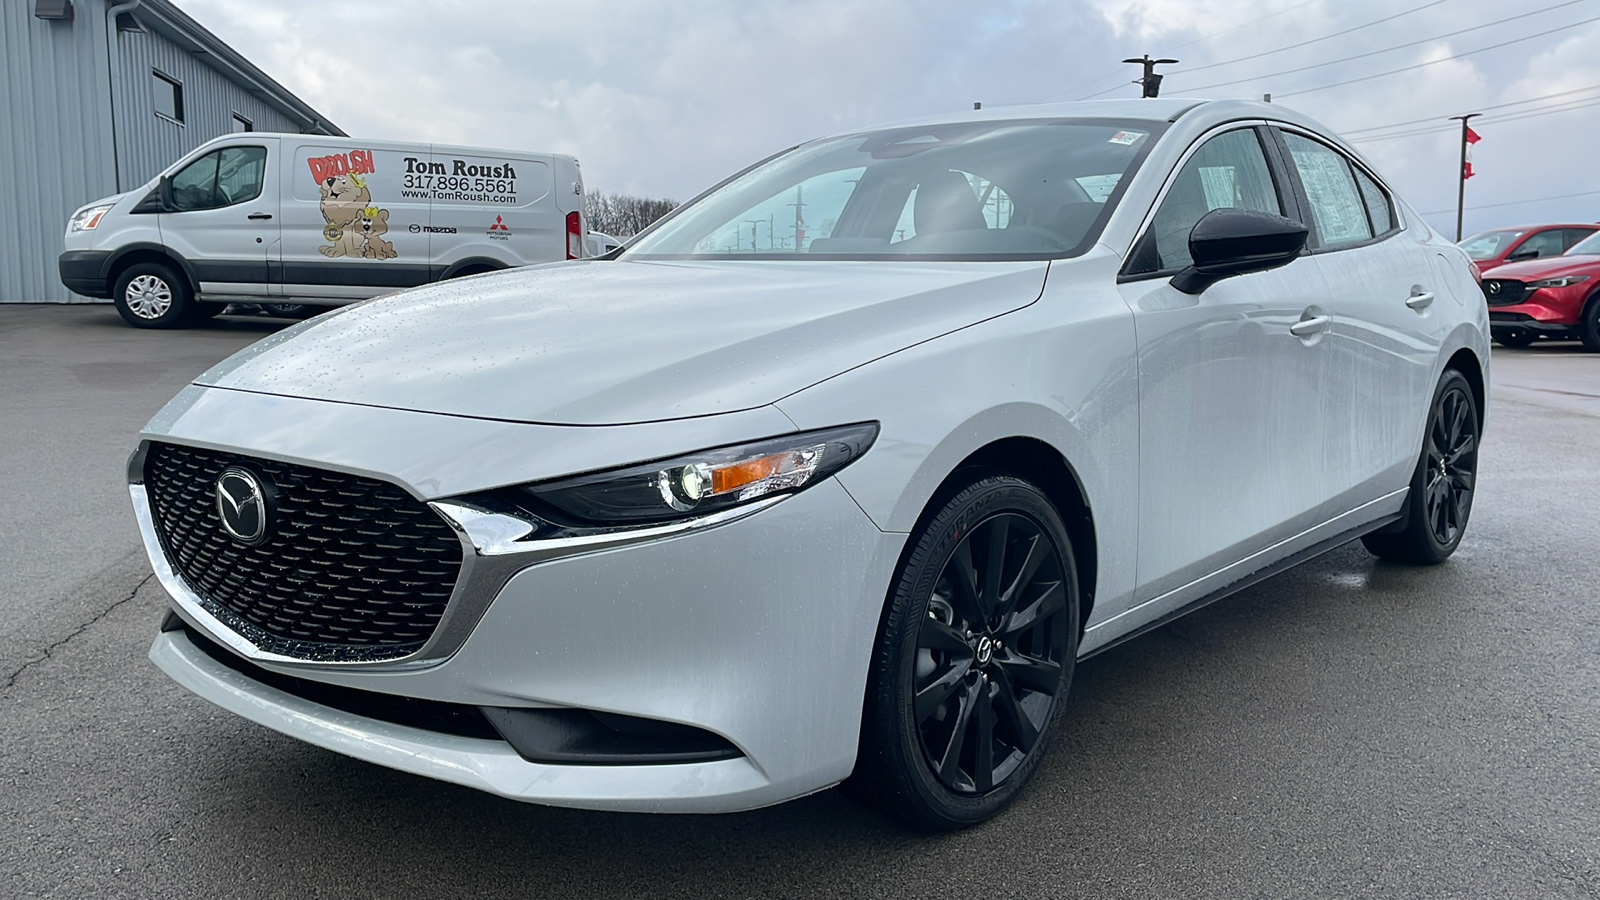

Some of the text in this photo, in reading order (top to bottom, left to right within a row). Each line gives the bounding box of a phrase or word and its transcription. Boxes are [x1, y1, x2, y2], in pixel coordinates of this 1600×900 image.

[403, 157, 517, 179] Tom Roush
[403, 174, 517, 194] 317.896.5561
[401, 190, 517, 203] www.TomRoush.com
